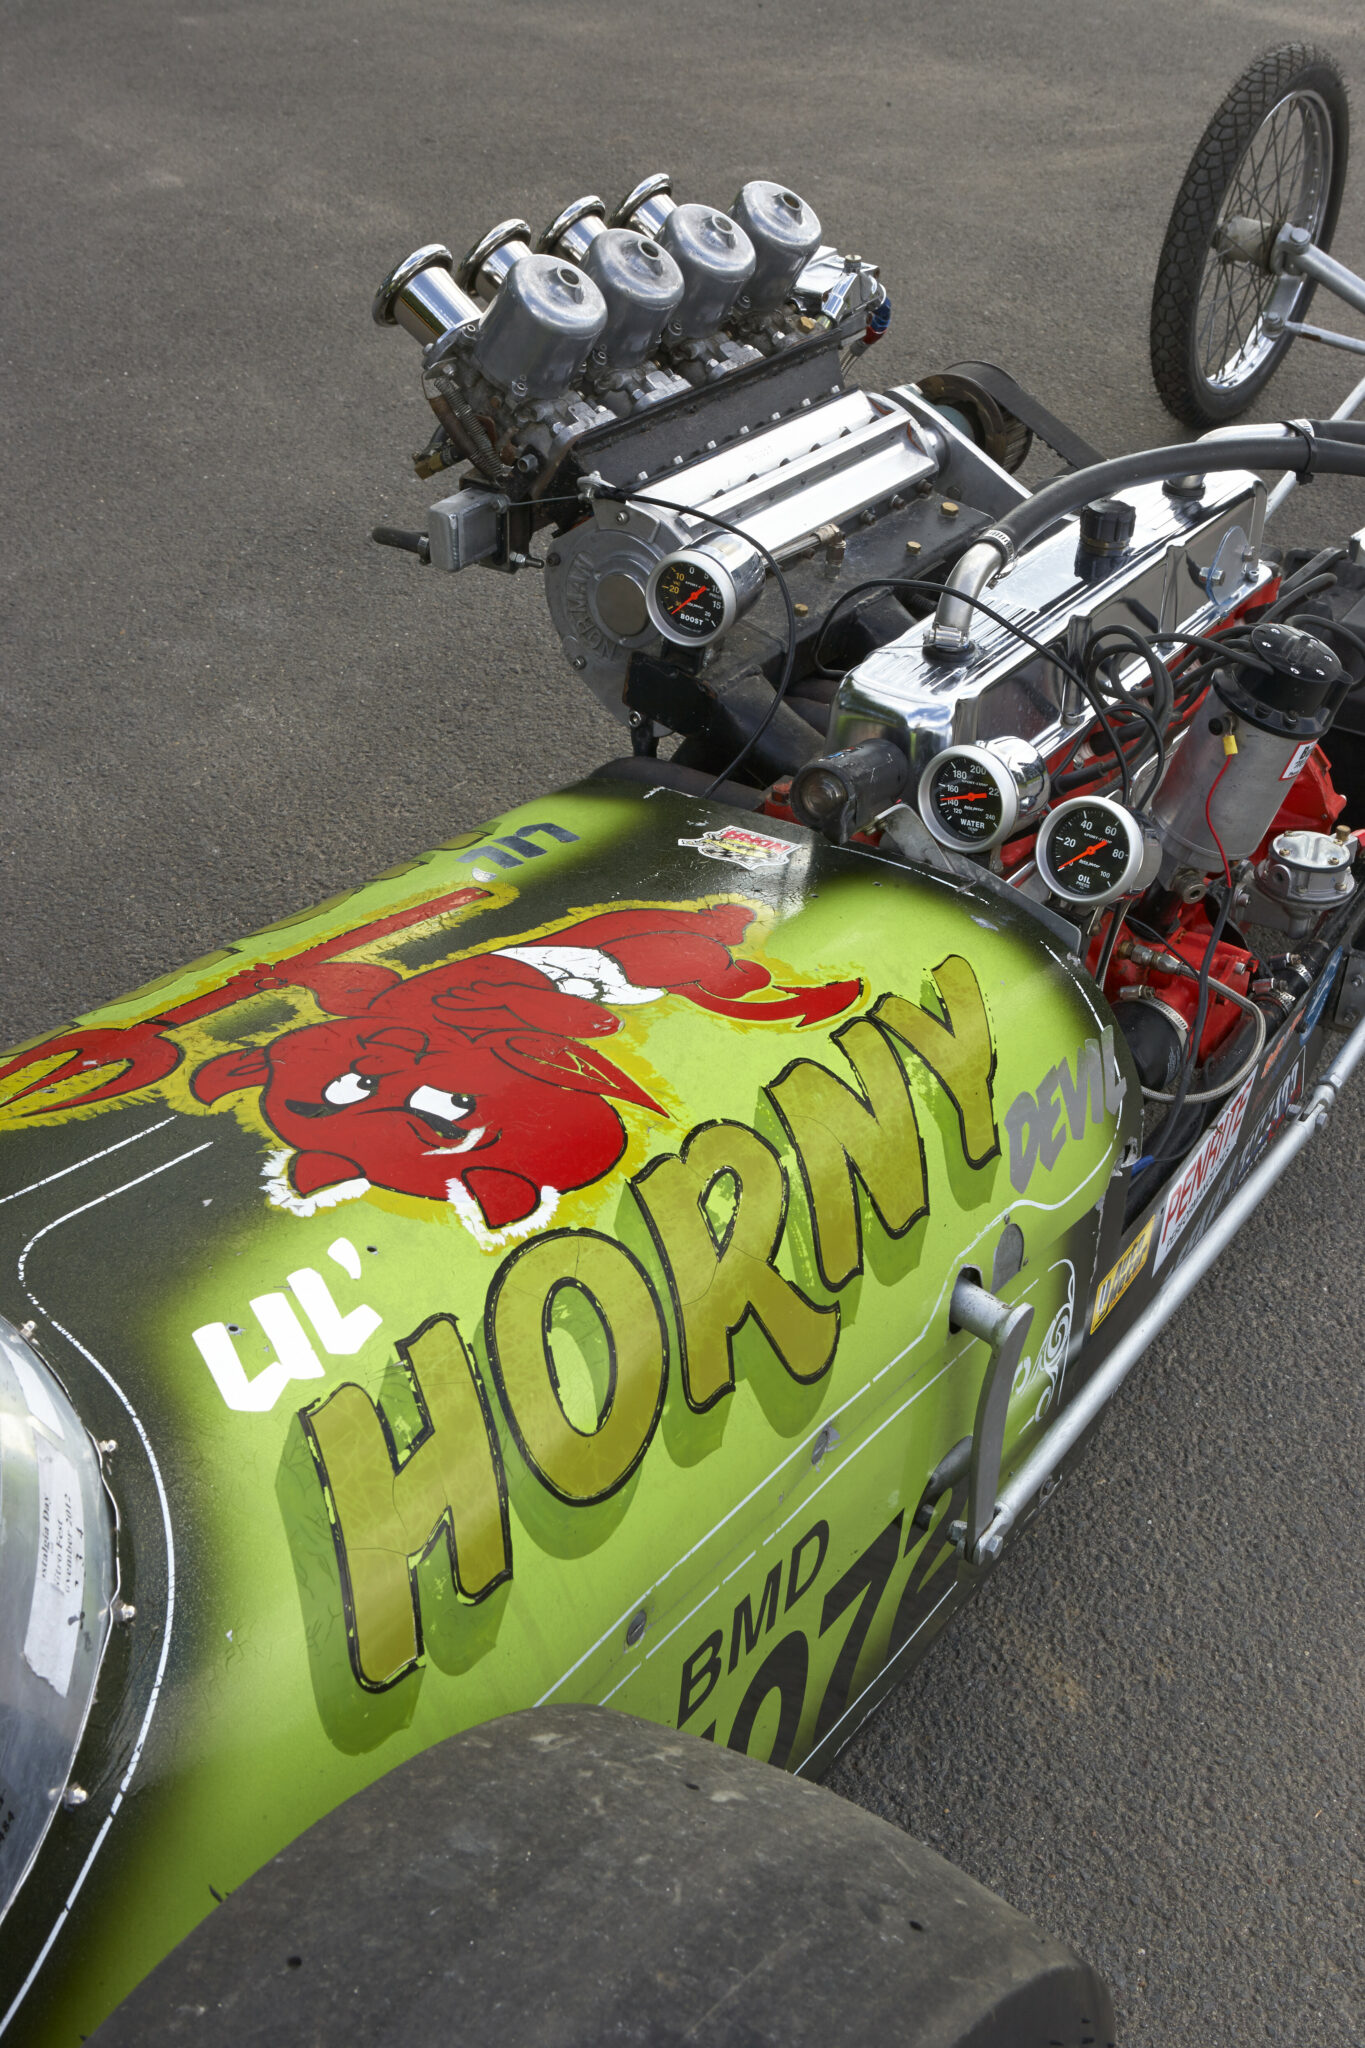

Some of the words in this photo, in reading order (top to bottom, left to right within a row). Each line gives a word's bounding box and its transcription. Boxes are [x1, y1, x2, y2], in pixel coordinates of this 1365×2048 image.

[689, 566, 695, 574] 0
[676, 572, 686, 581] 10
[669, 585, 680, 594] 20
[712, 584, 720, 594] 10
[712, 600, 721, 610] 15
[680, 613, 704, 626] BOOST
[952, 770, 967, 779] 180
[970, 765, 987, 775] 200
[947, 784, 959, 793] 160
[989, 787, 1000, 797] 22
[960, 818, 985, 829] WATER
[1080, 820, 1092, 830] 40
[1105, 826, 1117, 836] 60
[1064, 837, 1076, 848] 20
[1112, 849, 1124, 859] 80
[1078, 874, 1090, 884] OIL
[1004, 1024, 1127, 1194] DEVIL
[1161, 1077, 1253, 1244] PENRITE
[297, 953, 1003, 1694] HORNY
[677, 1519, 830, 1730] BMD
[700, 1470, 972, 1770] 072
